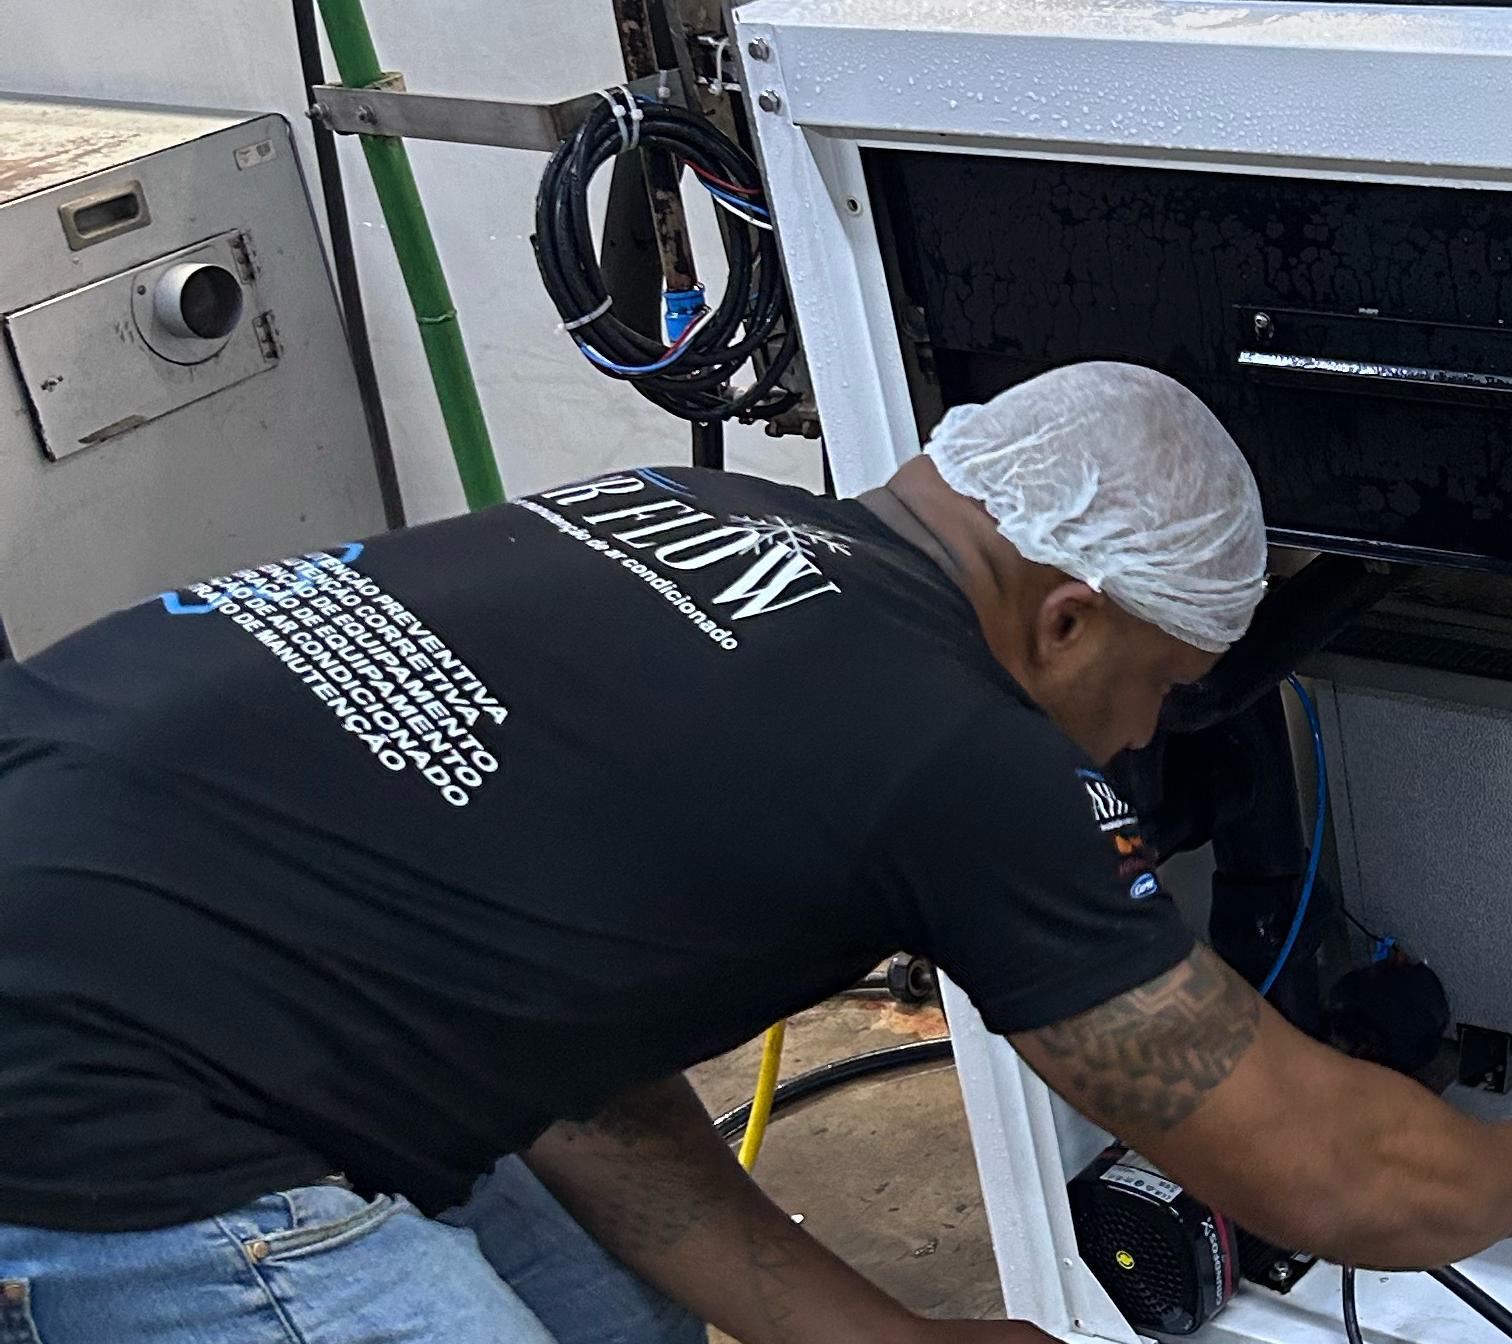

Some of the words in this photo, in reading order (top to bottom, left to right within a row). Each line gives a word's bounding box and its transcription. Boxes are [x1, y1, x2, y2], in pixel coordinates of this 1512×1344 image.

[582, 499, 842, 621] FLOW
[621, 558, 739, 651] condicionado
[232, 612, 265, 632] DE
[253, 628, 406, 772] MANUTENÇÃO
[245, 597, 277, 617] DE
[266, 613, 299, 633] AR
[291, 631, 469, 806] CONDICIONADO
[292, 607, 324, 627] DE
[314, 624, 482, 787] EQUIPAMENTO
[310, 595, 342, 616] DE
[331, 613, 498, 773] EQUIPAMENTO
[355, 605, 480, 726] CORRETIVA
[373, 594, 508, 724] PREVENTIVA
